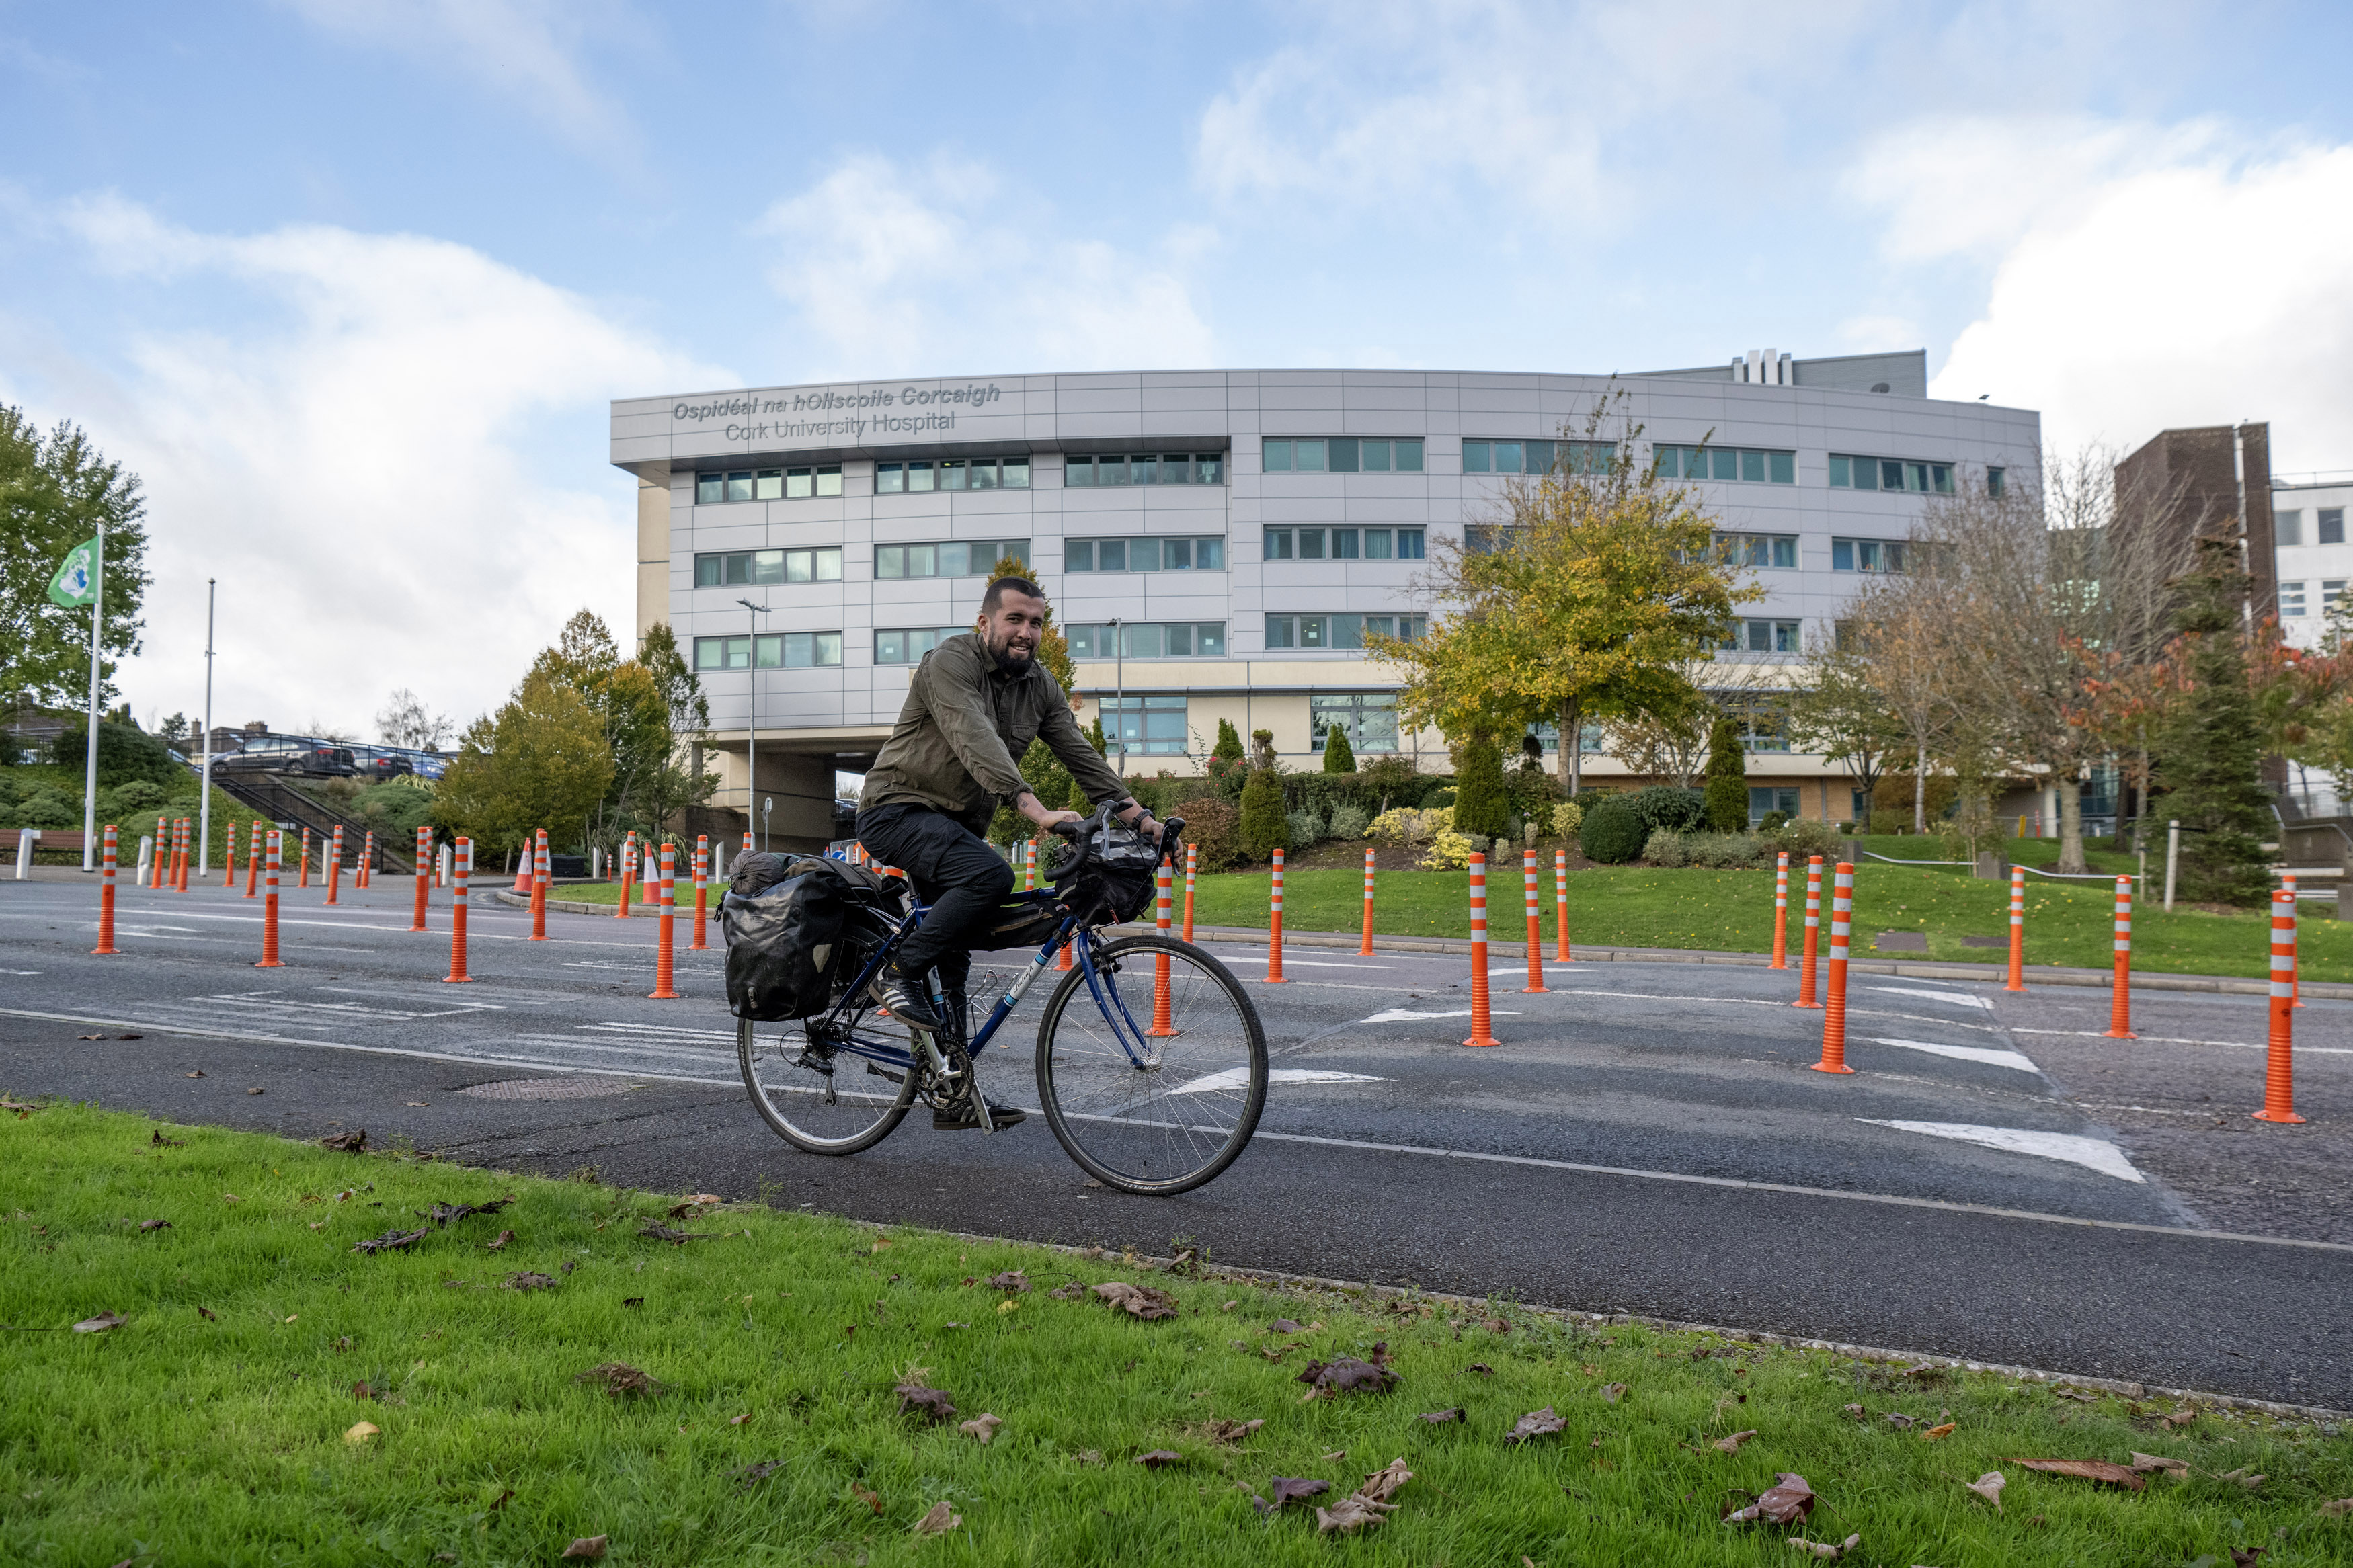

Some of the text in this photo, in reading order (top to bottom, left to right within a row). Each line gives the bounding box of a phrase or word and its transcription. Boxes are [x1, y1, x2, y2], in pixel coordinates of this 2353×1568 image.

[673, 383, 1000, 422] Ospidéal na hOllscoile Corcaigh
[725, 411, 955, 442] Cork University Hospital
[1123, 1182, 1158, 1190] PIRELLI
